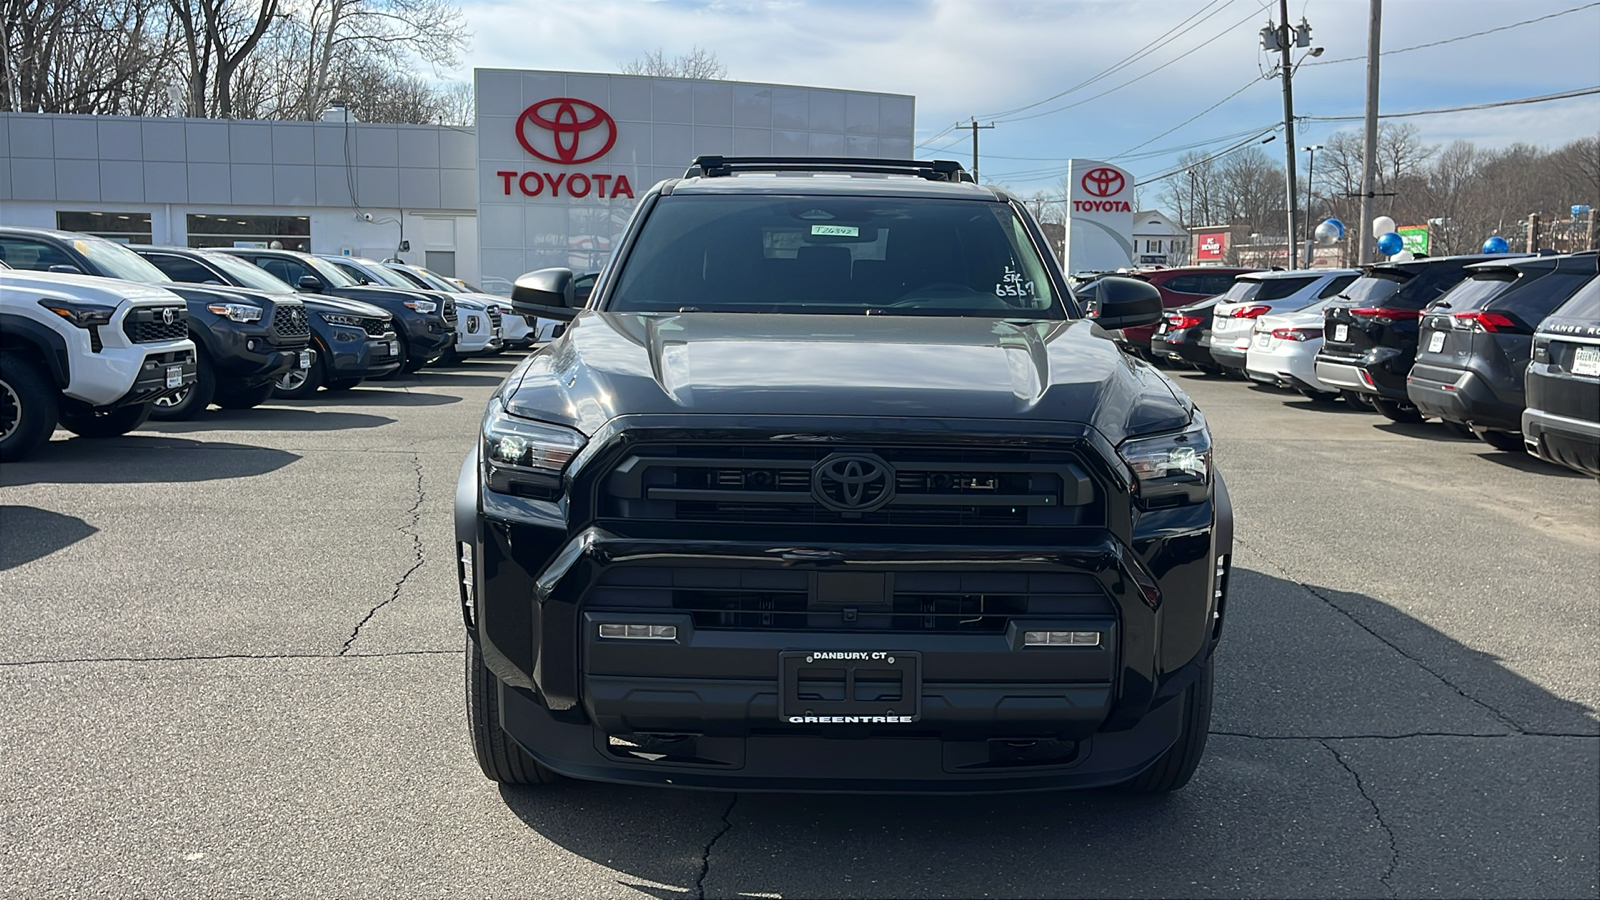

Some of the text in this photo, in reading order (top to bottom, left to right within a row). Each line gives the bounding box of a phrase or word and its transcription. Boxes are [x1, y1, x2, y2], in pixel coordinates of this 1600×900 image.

[497, 171, 635, 199] TOYOTA
[1073, 200, 1131, 212] TOYOTA
[1549, 324, 1582, 334] RANGE
[813, 652, 887, 661] DANBURY, CT
[788, 716, 913, 724] GREENTREE
